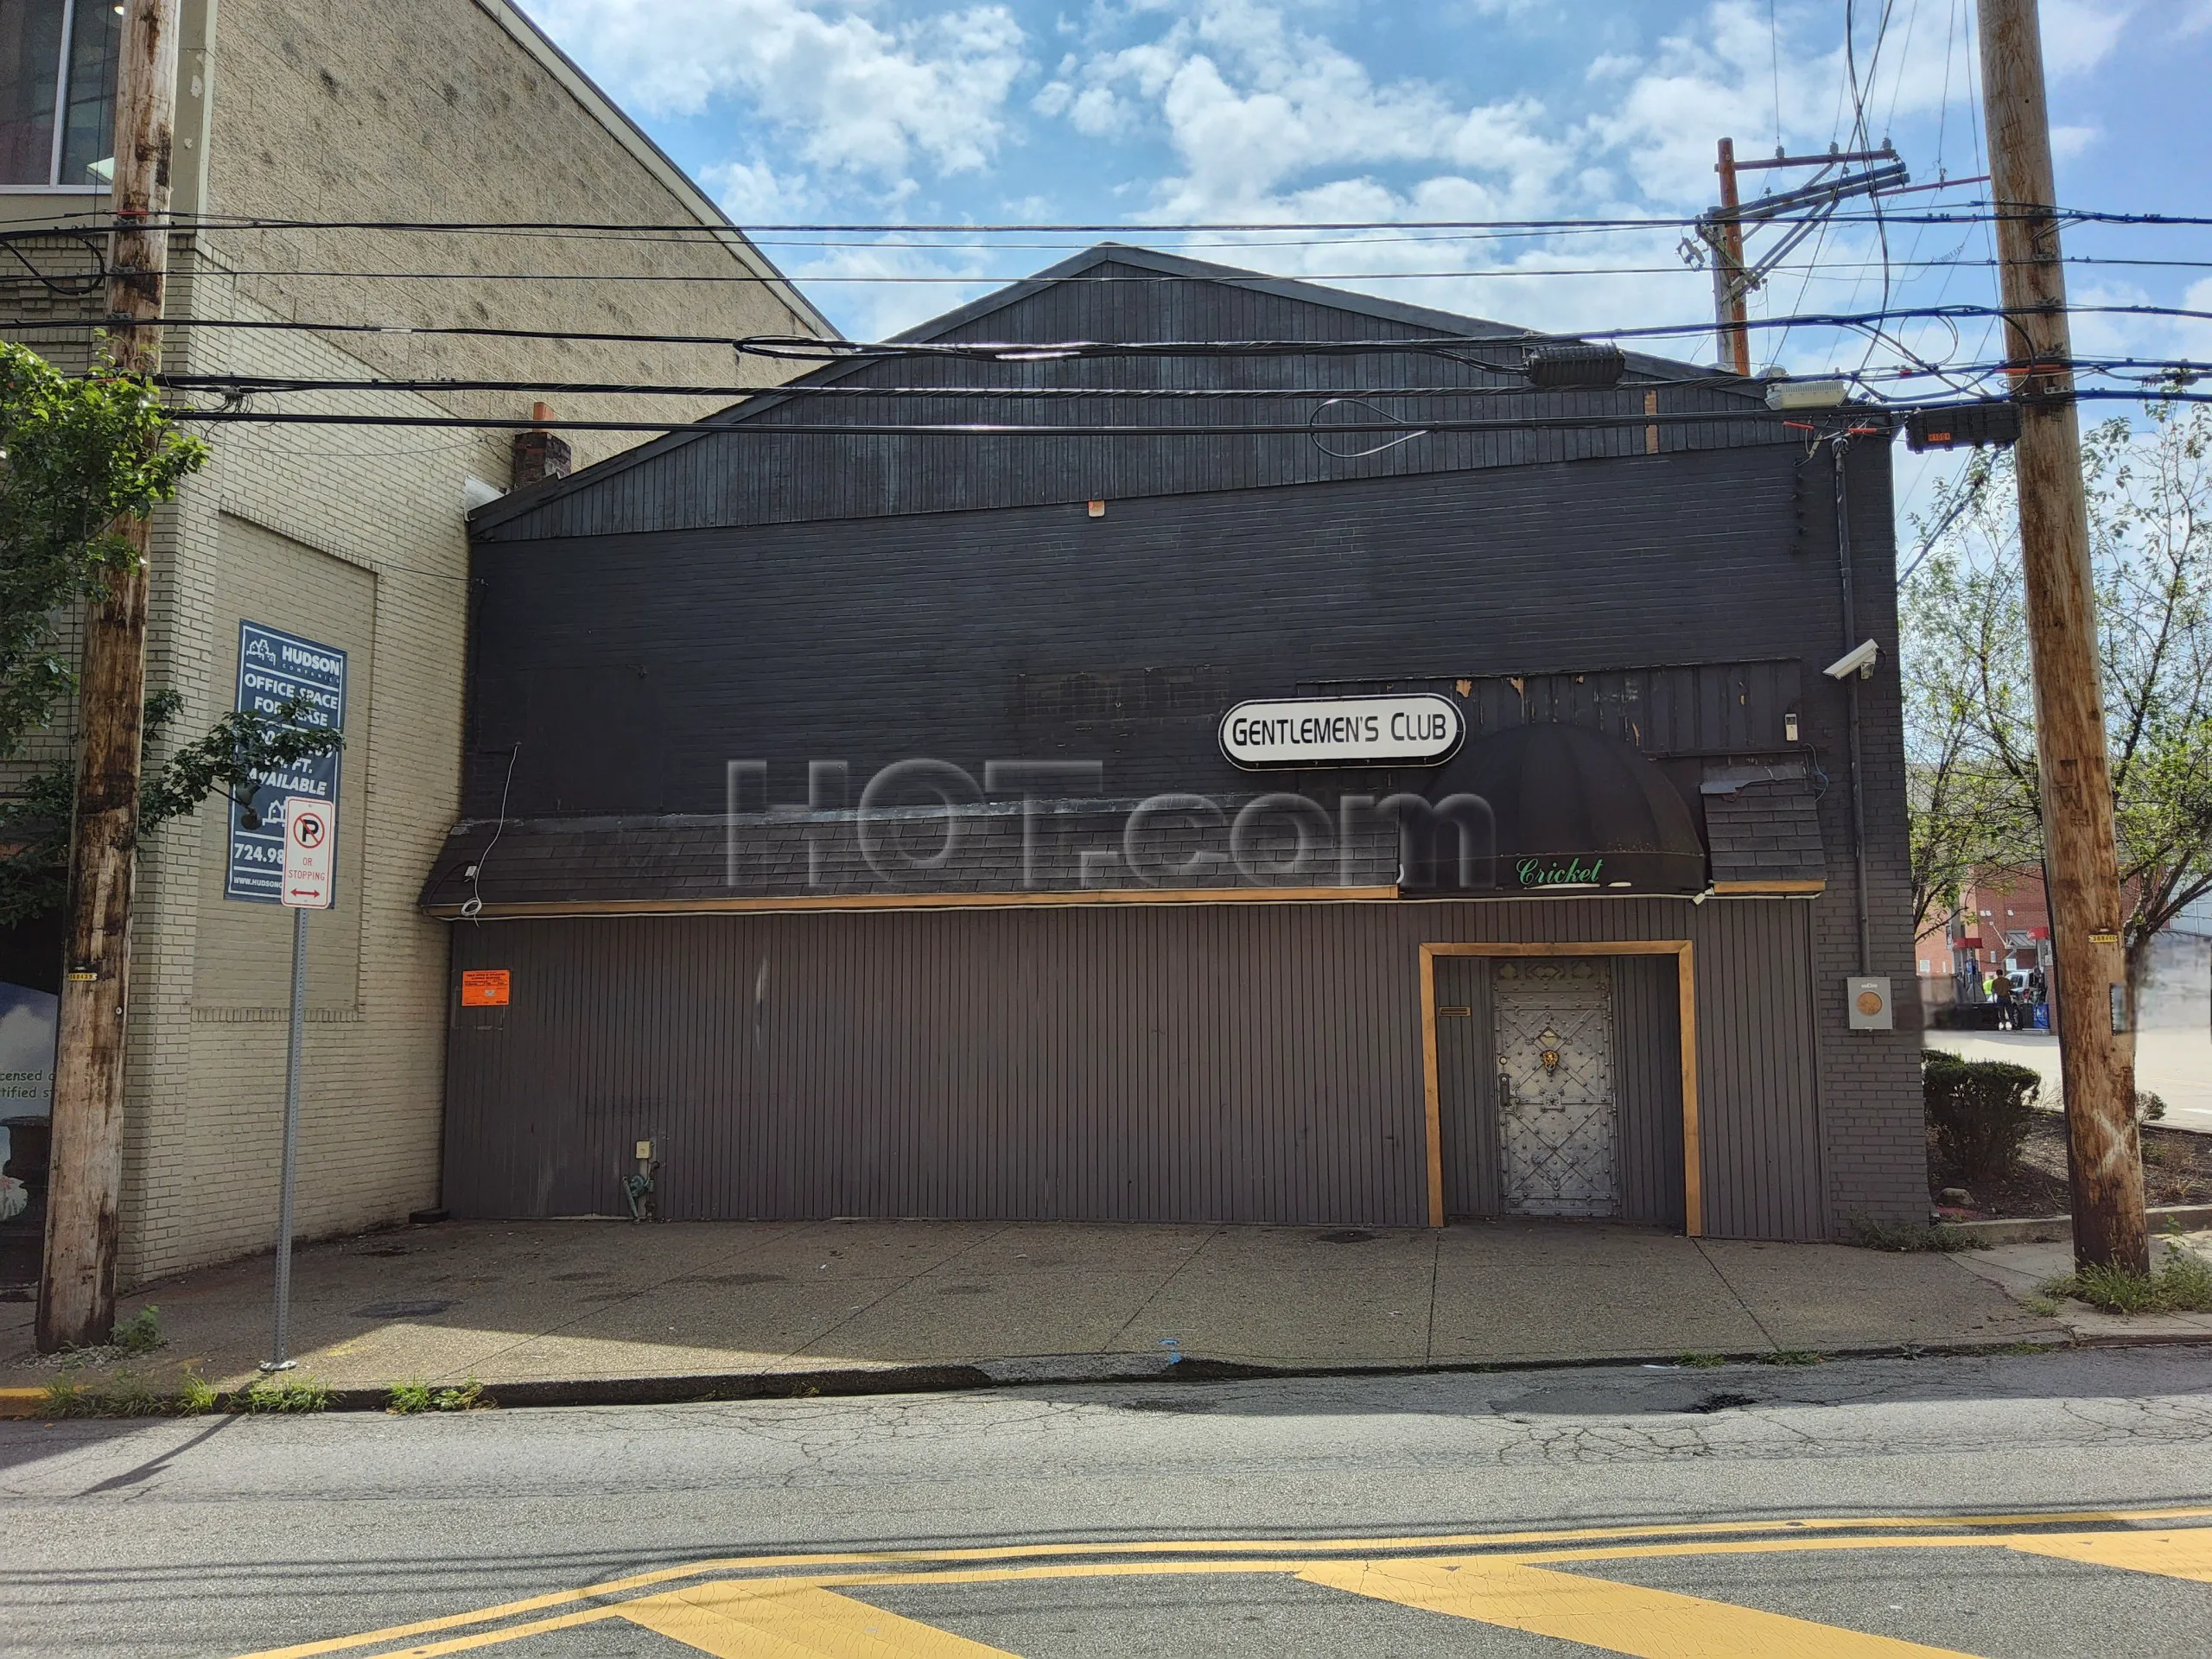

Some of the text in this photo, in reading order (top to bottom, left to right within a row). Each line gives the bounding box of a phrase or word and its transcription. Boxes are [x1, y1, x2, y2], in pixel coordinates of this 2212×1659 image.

[282, 645, 340, 676] HUDSON
[245, 673, 295, 698] OFFICE
[1232, 712, 1446, 746] GENTLEMEN'S CLUB
[302, 856, 313, 867] OR
[1516, 857, 1603, 885] Cricket
[288, 869, 326, 881] STOPPING
